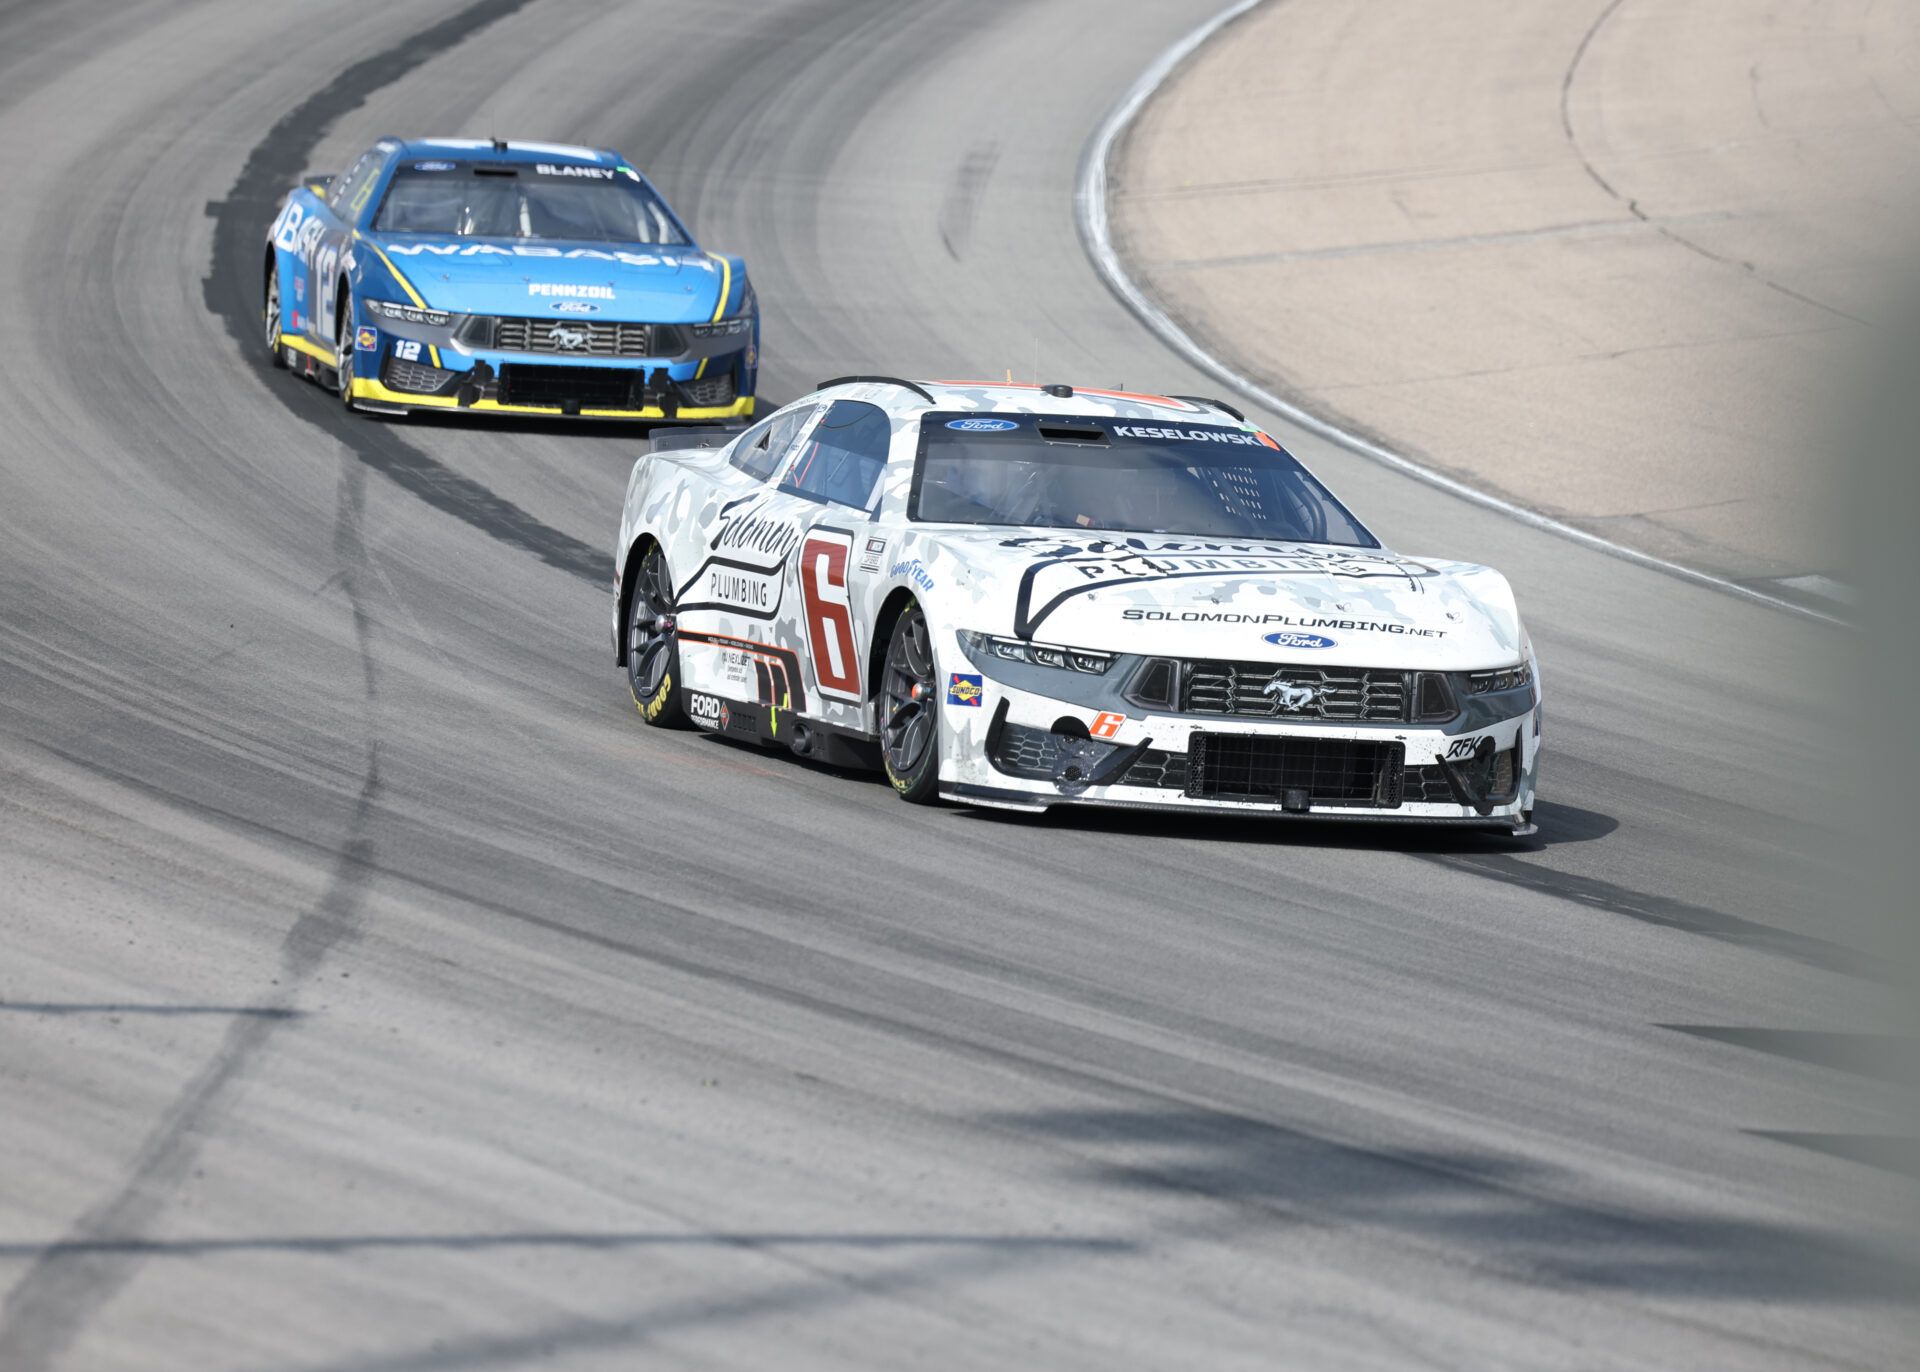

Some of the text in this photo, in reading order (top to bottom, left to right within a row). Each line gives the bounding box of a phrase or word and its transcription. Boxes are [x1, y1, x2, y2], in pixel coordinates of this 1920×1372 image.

[536, 163, 614, 180] BLANEY
[529, 283, 616, 300] PENNZOIL
[395, 339, 422, 362] 12
[710, 572, 767, 607] PLUMBING
[800, 536, 862, 698] 6
[950, 685, 981, 697] SUNOCO
[691, 693, 720, 718] FORD
[1090, 711, 1127, 740] 6
[1446, 735, 1483, 758] RFK
